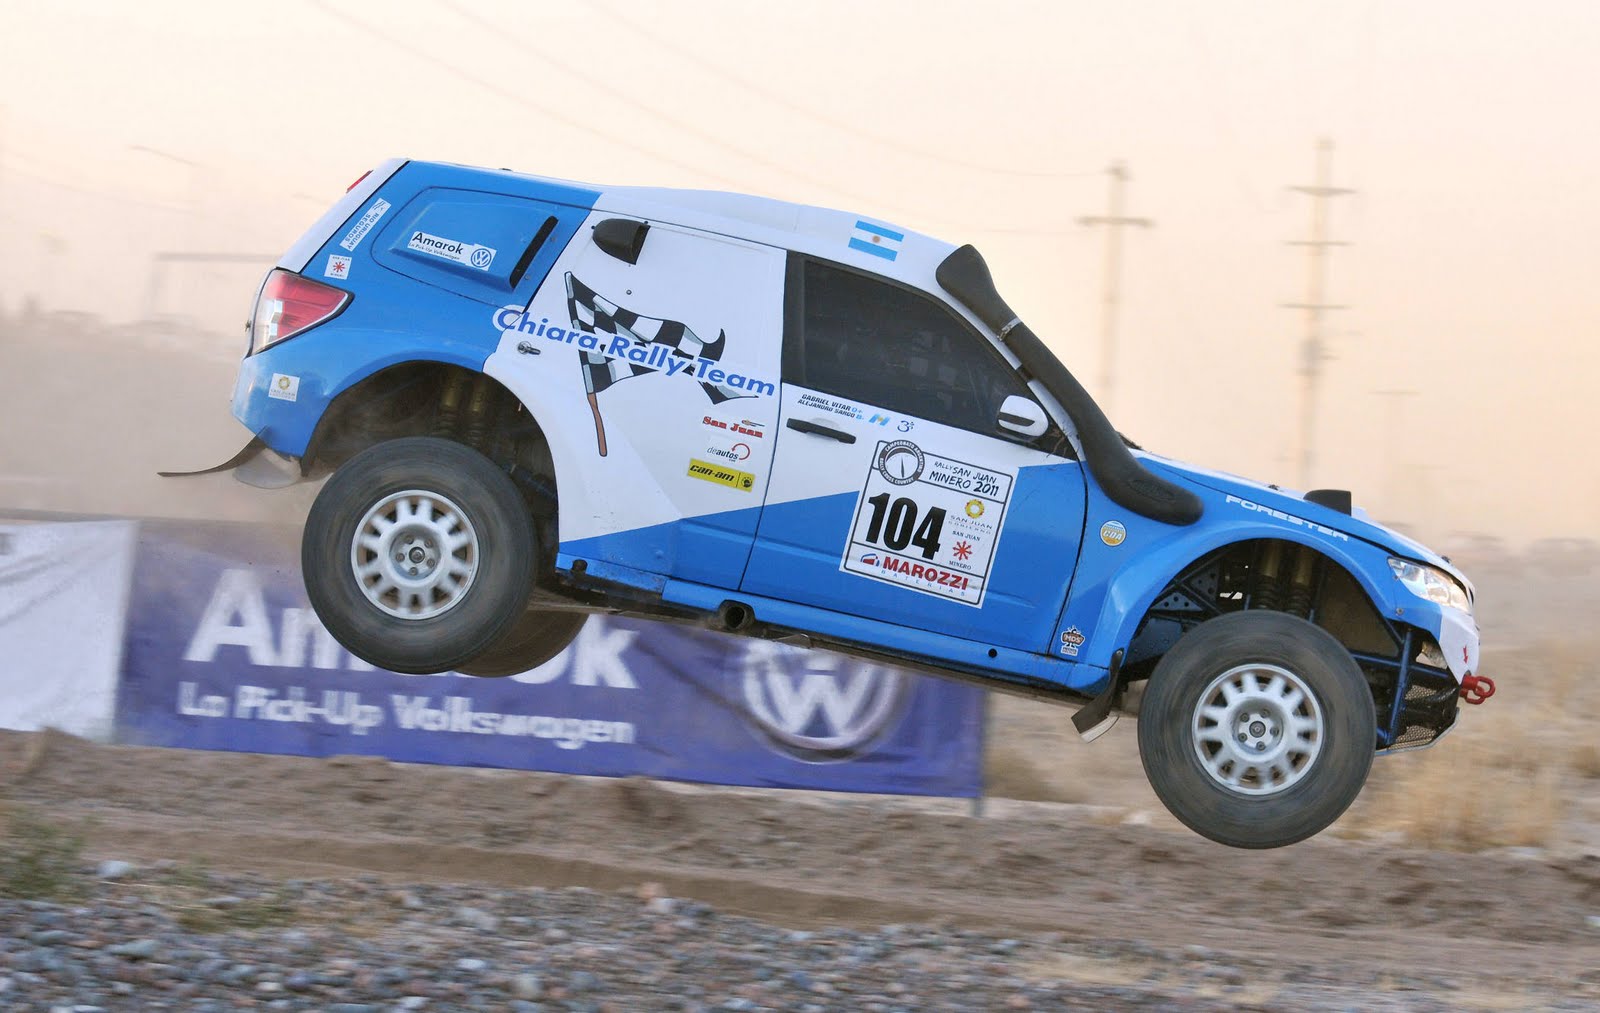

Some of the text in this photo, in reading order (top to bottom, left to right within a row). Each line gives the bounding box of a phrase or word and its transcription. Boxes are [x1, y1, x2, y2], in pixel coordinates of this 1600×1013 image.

[345, 213, 371, 242] SEGUROS
[347, 222, 371, 249] URUGUAY
[412, 232, 464, 255] Amarok
[496, 309, 775, 396] Chiara Rally Team
[801, 393, 829, 406] GABRIEL
[831, 401, 852, 412] VITAR
[703, 416, 763, 438] San Juan
[707, 446, 739, 460] deautos
[690, 464, 735, 482] can-am
[929, 471, 999, 497] MINERO 2011
[934, 461, 997, 484] RALLY SAN JUAN
[866, 492, 947, 560] 104
[951, 515, 993, 530] SAN JUAN
[1225, 494, 1349, 541] FORESTER
[965, 532, 981, 541] JUAN
[883, 556, 969, 591] MAROZZI
[949, 560, 972, 571] MINERO
[388, 693, 637, 750] Volkswagen
